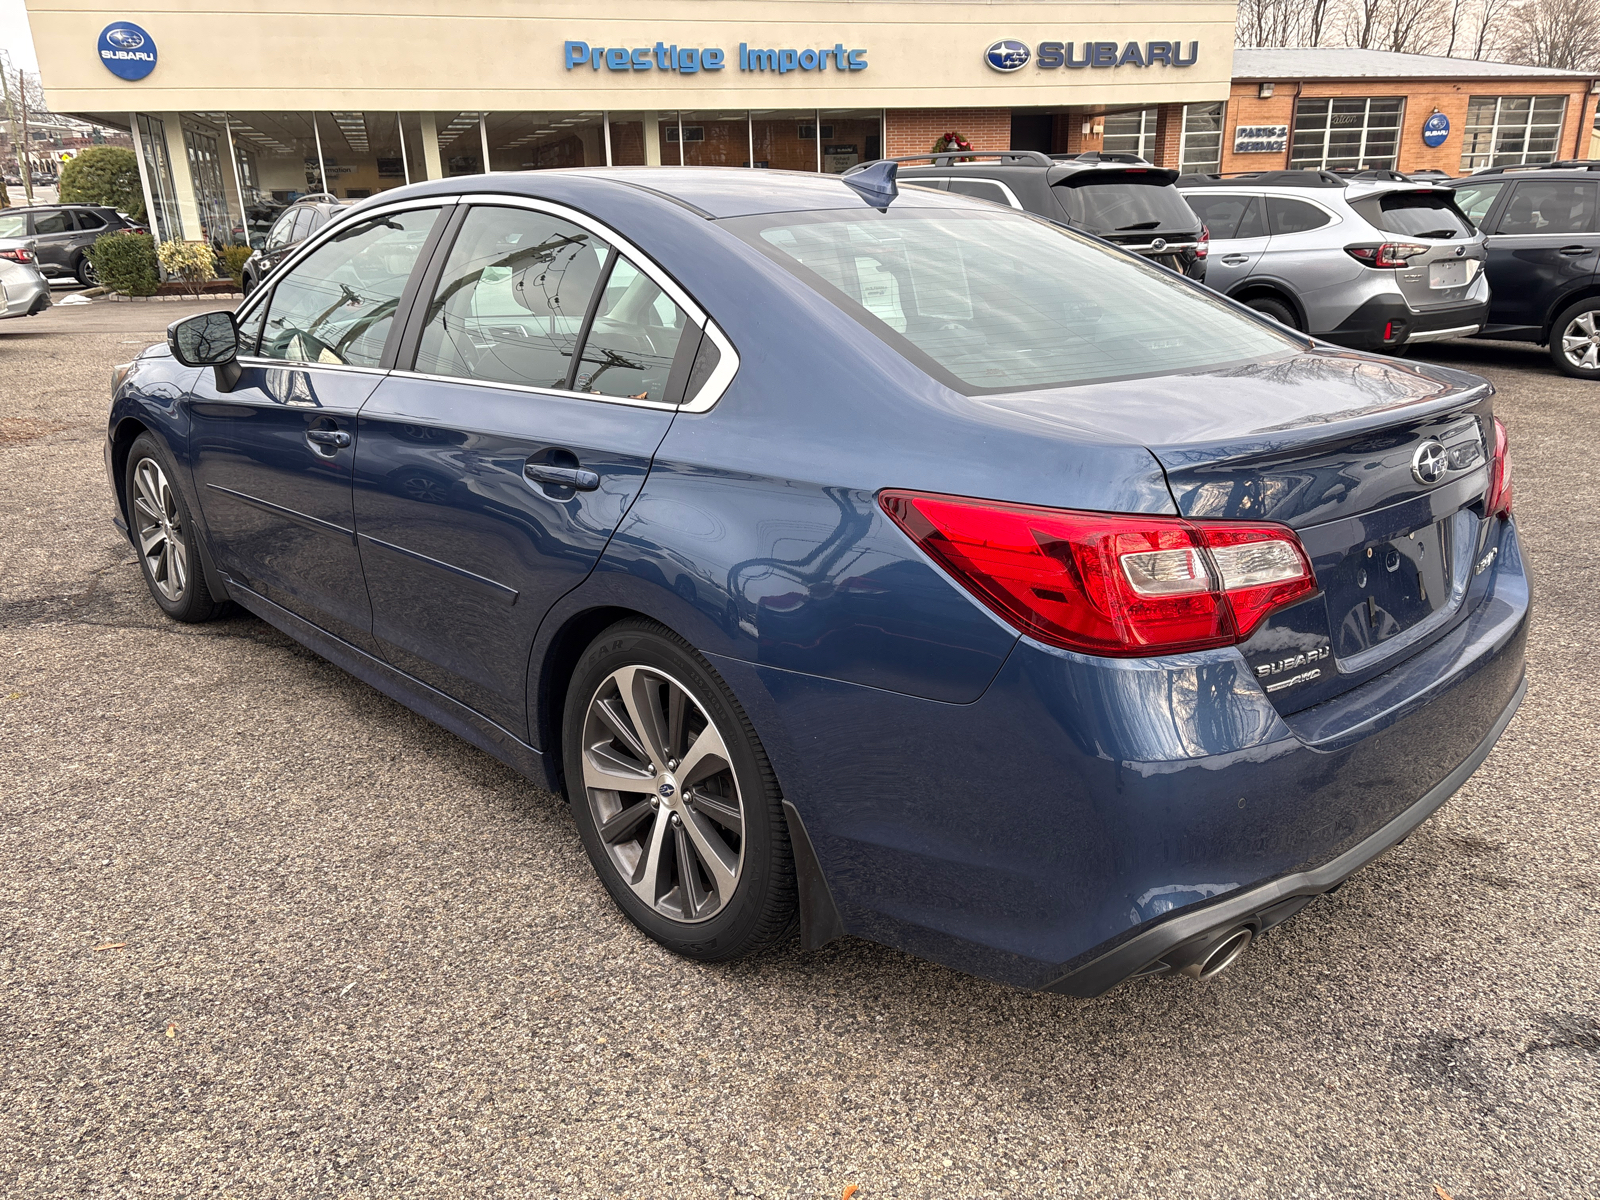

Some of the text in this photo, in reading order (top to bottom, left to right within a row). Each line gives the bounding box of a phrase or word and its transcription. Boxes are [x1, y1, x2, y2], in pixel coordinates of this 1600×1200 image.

[101, 50, 154, 61] SUBARU
[564, 40, 869, 73] Prestige Imports
[1037, 40, 1199, 68] SUBARU
[1237, 126, 1277, 139] PARTS
[1424, 129, 1449, 137] SUBARU
[1235, 140, 1287, 152] SERVICE
[1255, 646, 1330, 677] SUBARU
